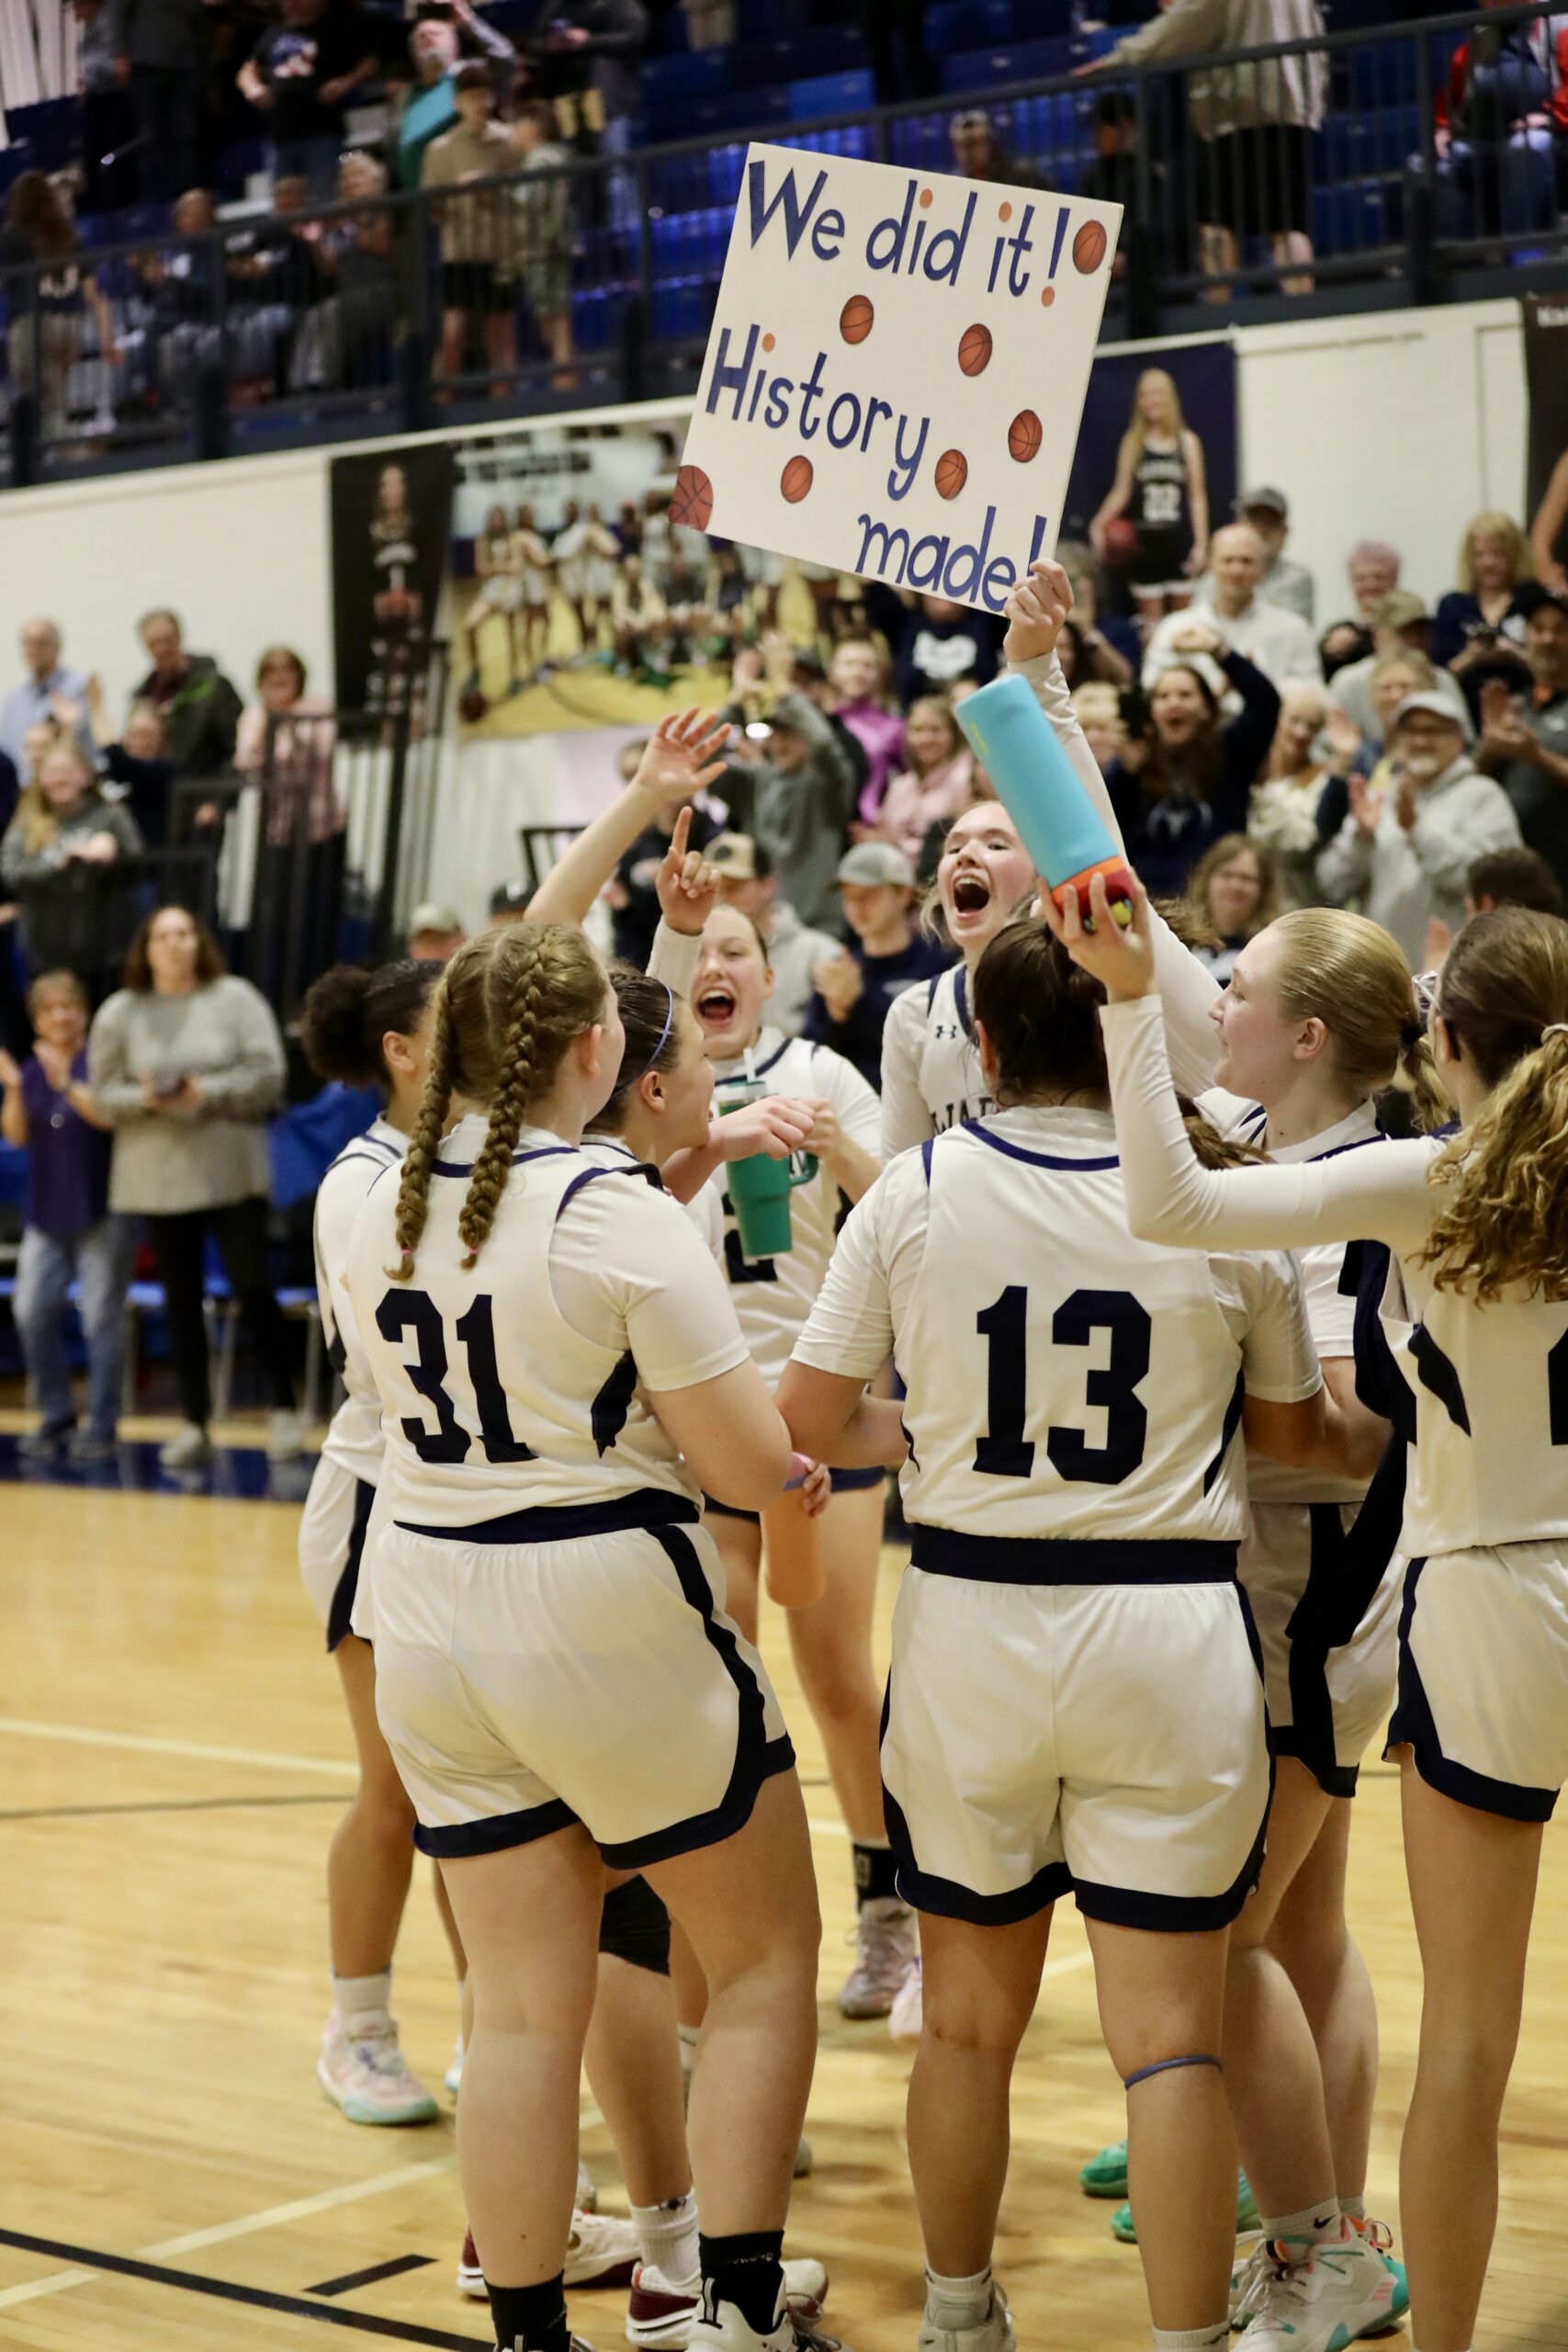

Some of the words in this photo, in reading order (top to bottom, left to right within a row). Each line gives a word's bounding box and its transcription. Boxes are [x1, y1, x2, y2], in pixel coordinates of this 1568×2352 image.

[749, 160, 845, 263] We
[866, 179, 977, 287] did
[705, 323, 931, 501] History
[375, 1288, 539, 1464] 31
[972, 1285, 1152, 1485] 13
